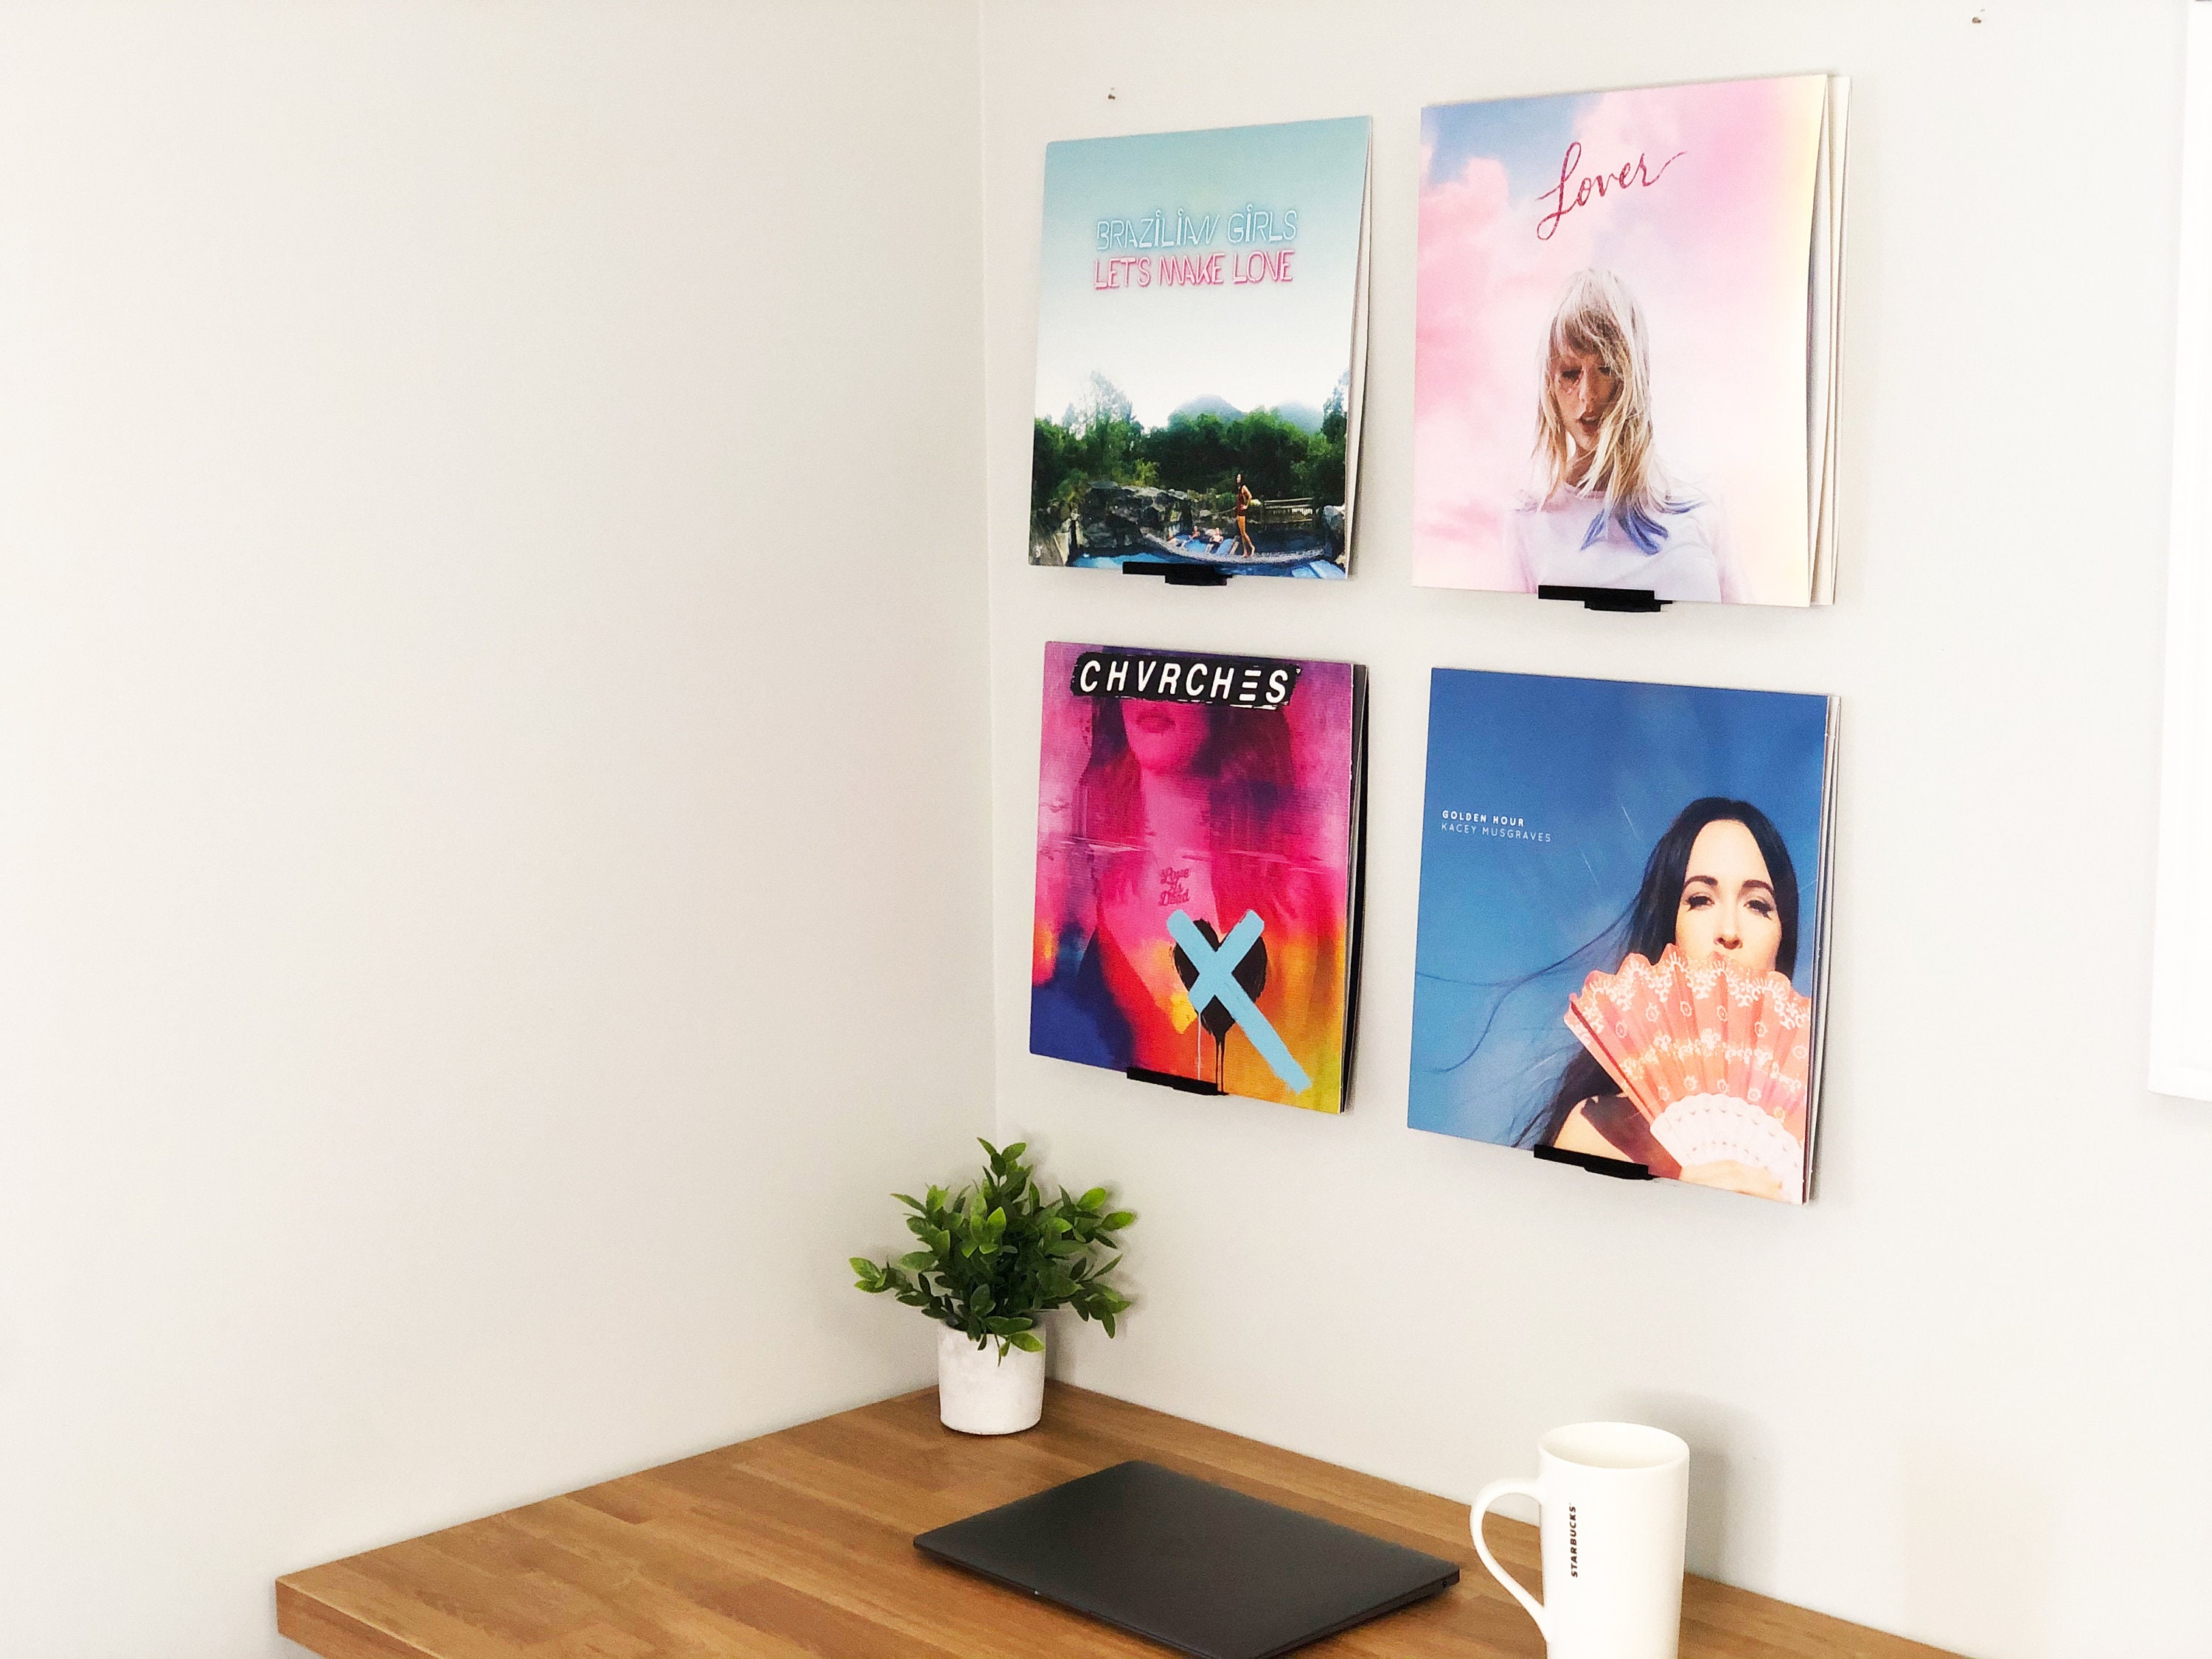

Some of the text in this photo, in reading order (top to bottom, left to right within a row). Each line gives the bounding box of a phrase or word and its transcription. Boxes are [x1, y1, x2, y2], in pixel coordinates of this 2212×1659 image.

[1535, 141, 1687, 240] Lover
[1095, 248, 1296, 291] LET'S MAKE LOVE
[1441, 810, 1525, 827] GOLDEN HOUR
[1441, 822, 1551, 842] KACEY MUSGRAVES
[1568, 1506, 1579, 1578] STARBUCKS
